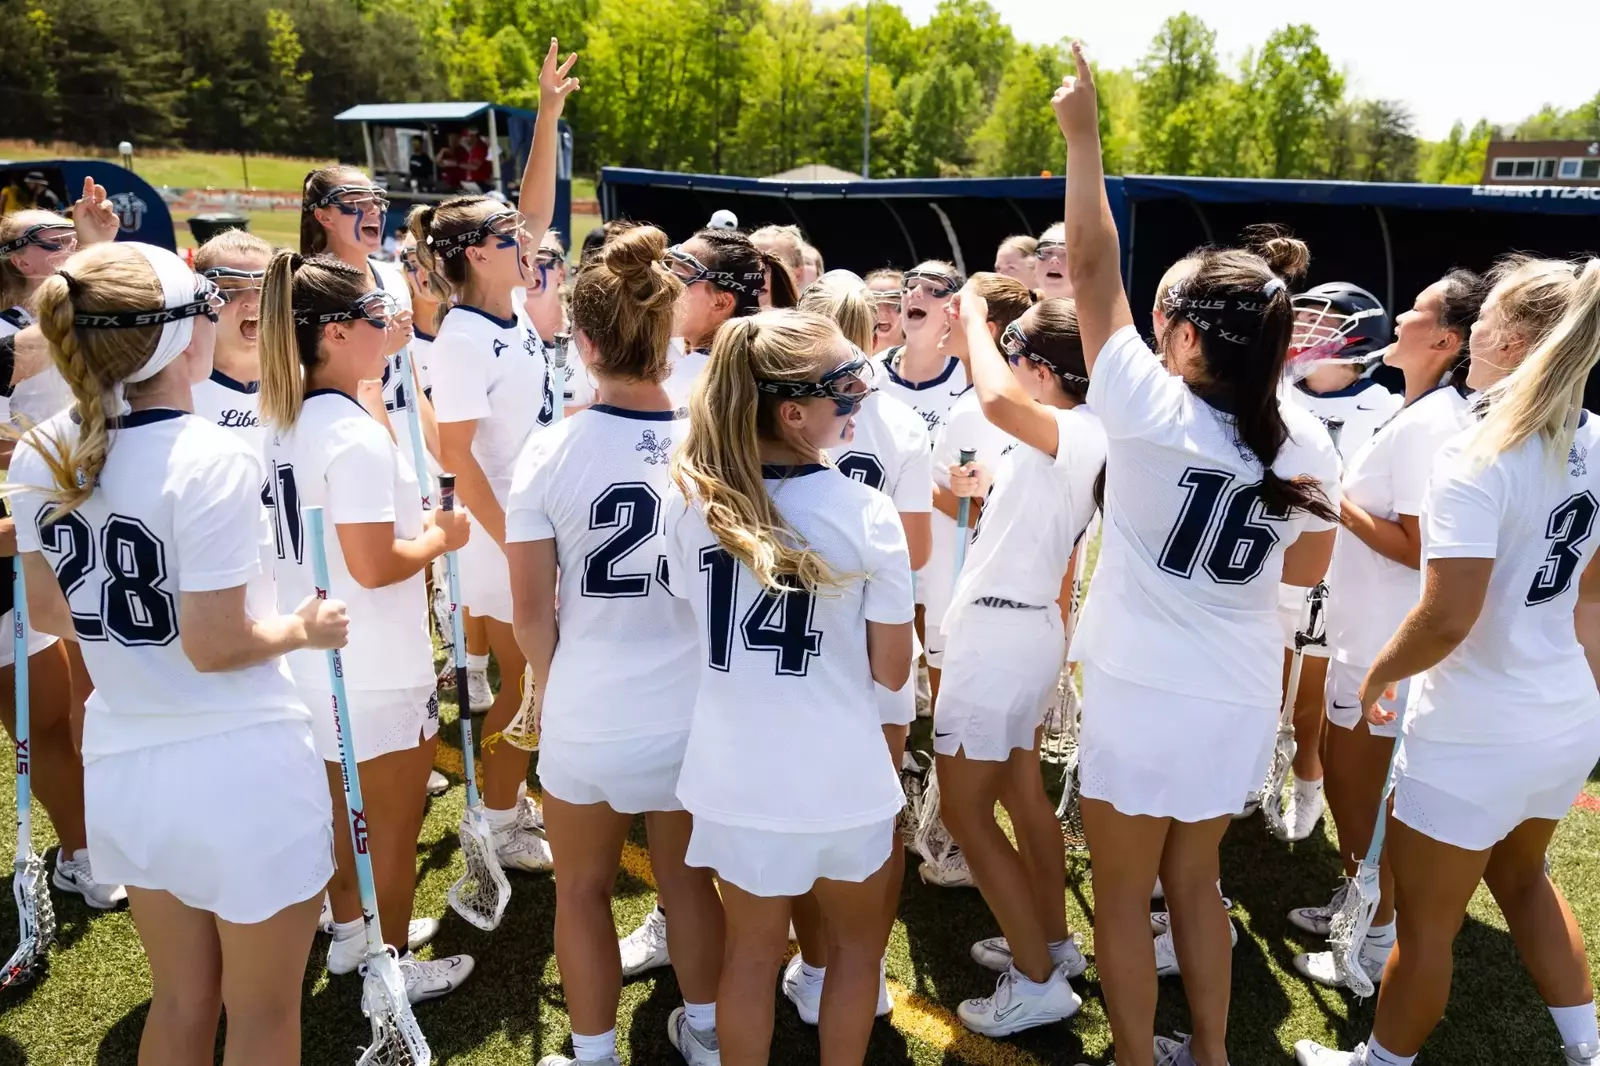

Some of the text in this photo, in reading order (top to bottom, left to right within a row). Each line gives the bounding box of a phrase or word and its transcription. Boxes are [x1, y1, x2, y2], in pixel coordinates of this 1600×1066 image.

[435, 238, 452, 248] STX
[457, 229, 481, 242] STX
[445, 245, 464, 258] STX
[706, 271, 734, 280] STX
[718, 280, 747, 293] STX
[75, 302, 211, 326] STX STX ST
[320, 311, 353, 323] STX
[1029, 353, 1058, 371] STX
[1157, 467, 1290, 585] 16
[581, 481, 672, 598] 2
[1525, 490, 1600, 607] 3
[35, 502, 180, 647] 28
[699, 543, 823, 677] 14
[15, 738, 28, 775] STX
[351, 808, 368, 854] STX
